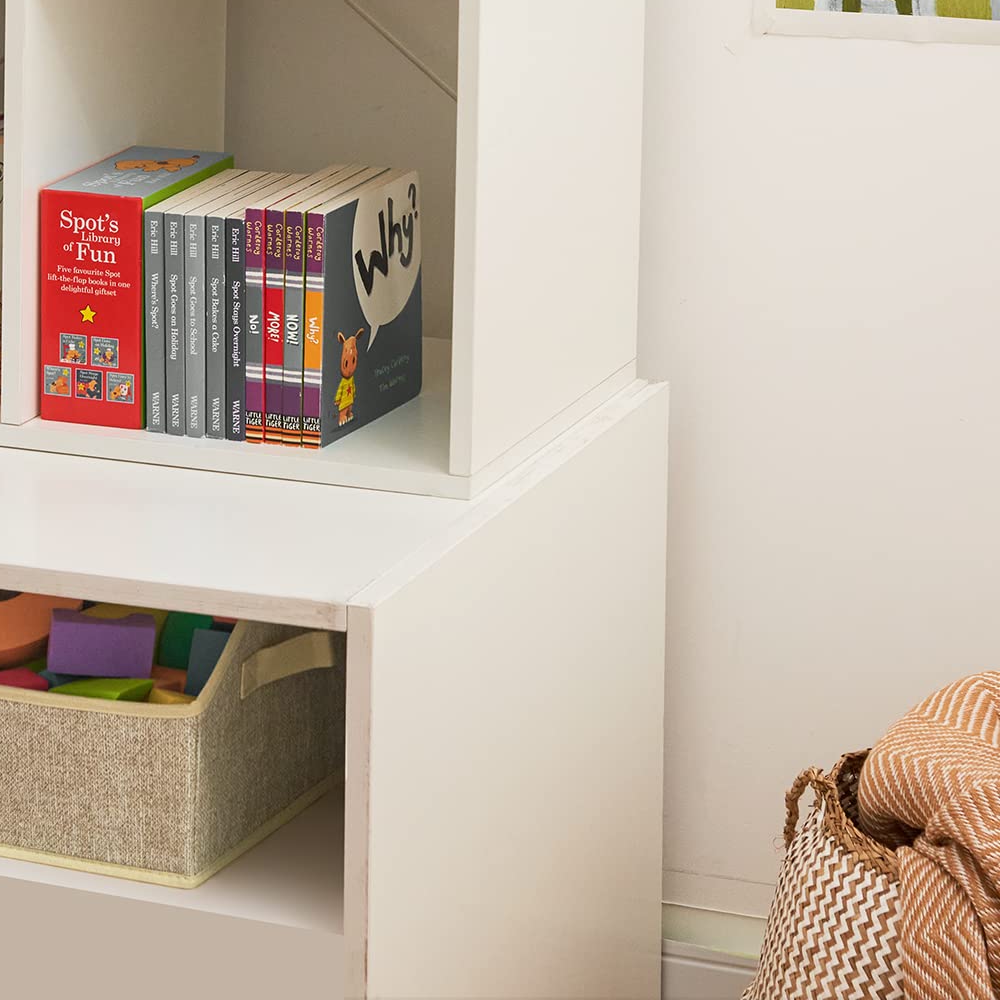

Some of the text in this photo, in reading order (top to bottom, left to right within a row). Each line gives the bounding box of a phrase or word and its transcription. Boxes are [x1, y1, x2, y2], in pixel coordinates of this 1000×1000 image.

[59, 209, 119, 234] Spot's
[150, 220, 159, 254] Eric Hill
[253, 220, 262, 255] Corderoy
[63, 241, 117, 265] of Fun
[81, 231, 121, 246] Library
[170, 221, 178, 256] Eric Hill
[189, 223, 198, 258] Eric Hill
[211, 225, 219, 260] Eric Hill
[232, 228, 240, 263] Eric Hill
[274, 223, 283, 258] Corderoy
[293, 225, 302, 260] Corderoy
[314, 226, 324, 261] Corderoy
[355, 182, 419, 297] Why?
[47, 273, 87, 286] lift-the-flap
[88, 276, 108, 287] books
[109, 278, 117, 287] in
[57, 265, 121, 279] Five favourite Spot
[210, 277, 219, 297] Spot
[60, 284, 117, 297] delightful giftset
[150, 273, 159, 329] Where's Spot?
[169, 274, 179, 360] Spot Goes on Holiday
[188, 276, 198, 355] Spot Goes to School
[211, 298, 220, 324] Bakes
[231, 280, 241, 368] Spot Stays Overnight
[249, 314, 260, 335] No!
[266, 311, 280, 343] MORE!
[211, 331, 220, 353] Cake
[286, 314, 300, 346] NOW!
[306, 317, 321, 345] Why?
[152, 391, 160, 426] WARNE
[172, 393, 180, 428] WARNE
[190, 395, 198, 429] WARNE
[212, 397, 220, 432] WARNE
[232, 400, 240, 434] WARNE
[245, 411, 262, 419] LITTLE
[245, 418, 263, 426] TIGER
[265, 413, 282, 421] LITTLE
[265, 419, 282, 428] TIGER
[282, 415, 300, 423] LITTLE
[283, 422, 300, 430] TIGER
[303, 423, 321, 432] TIGER
